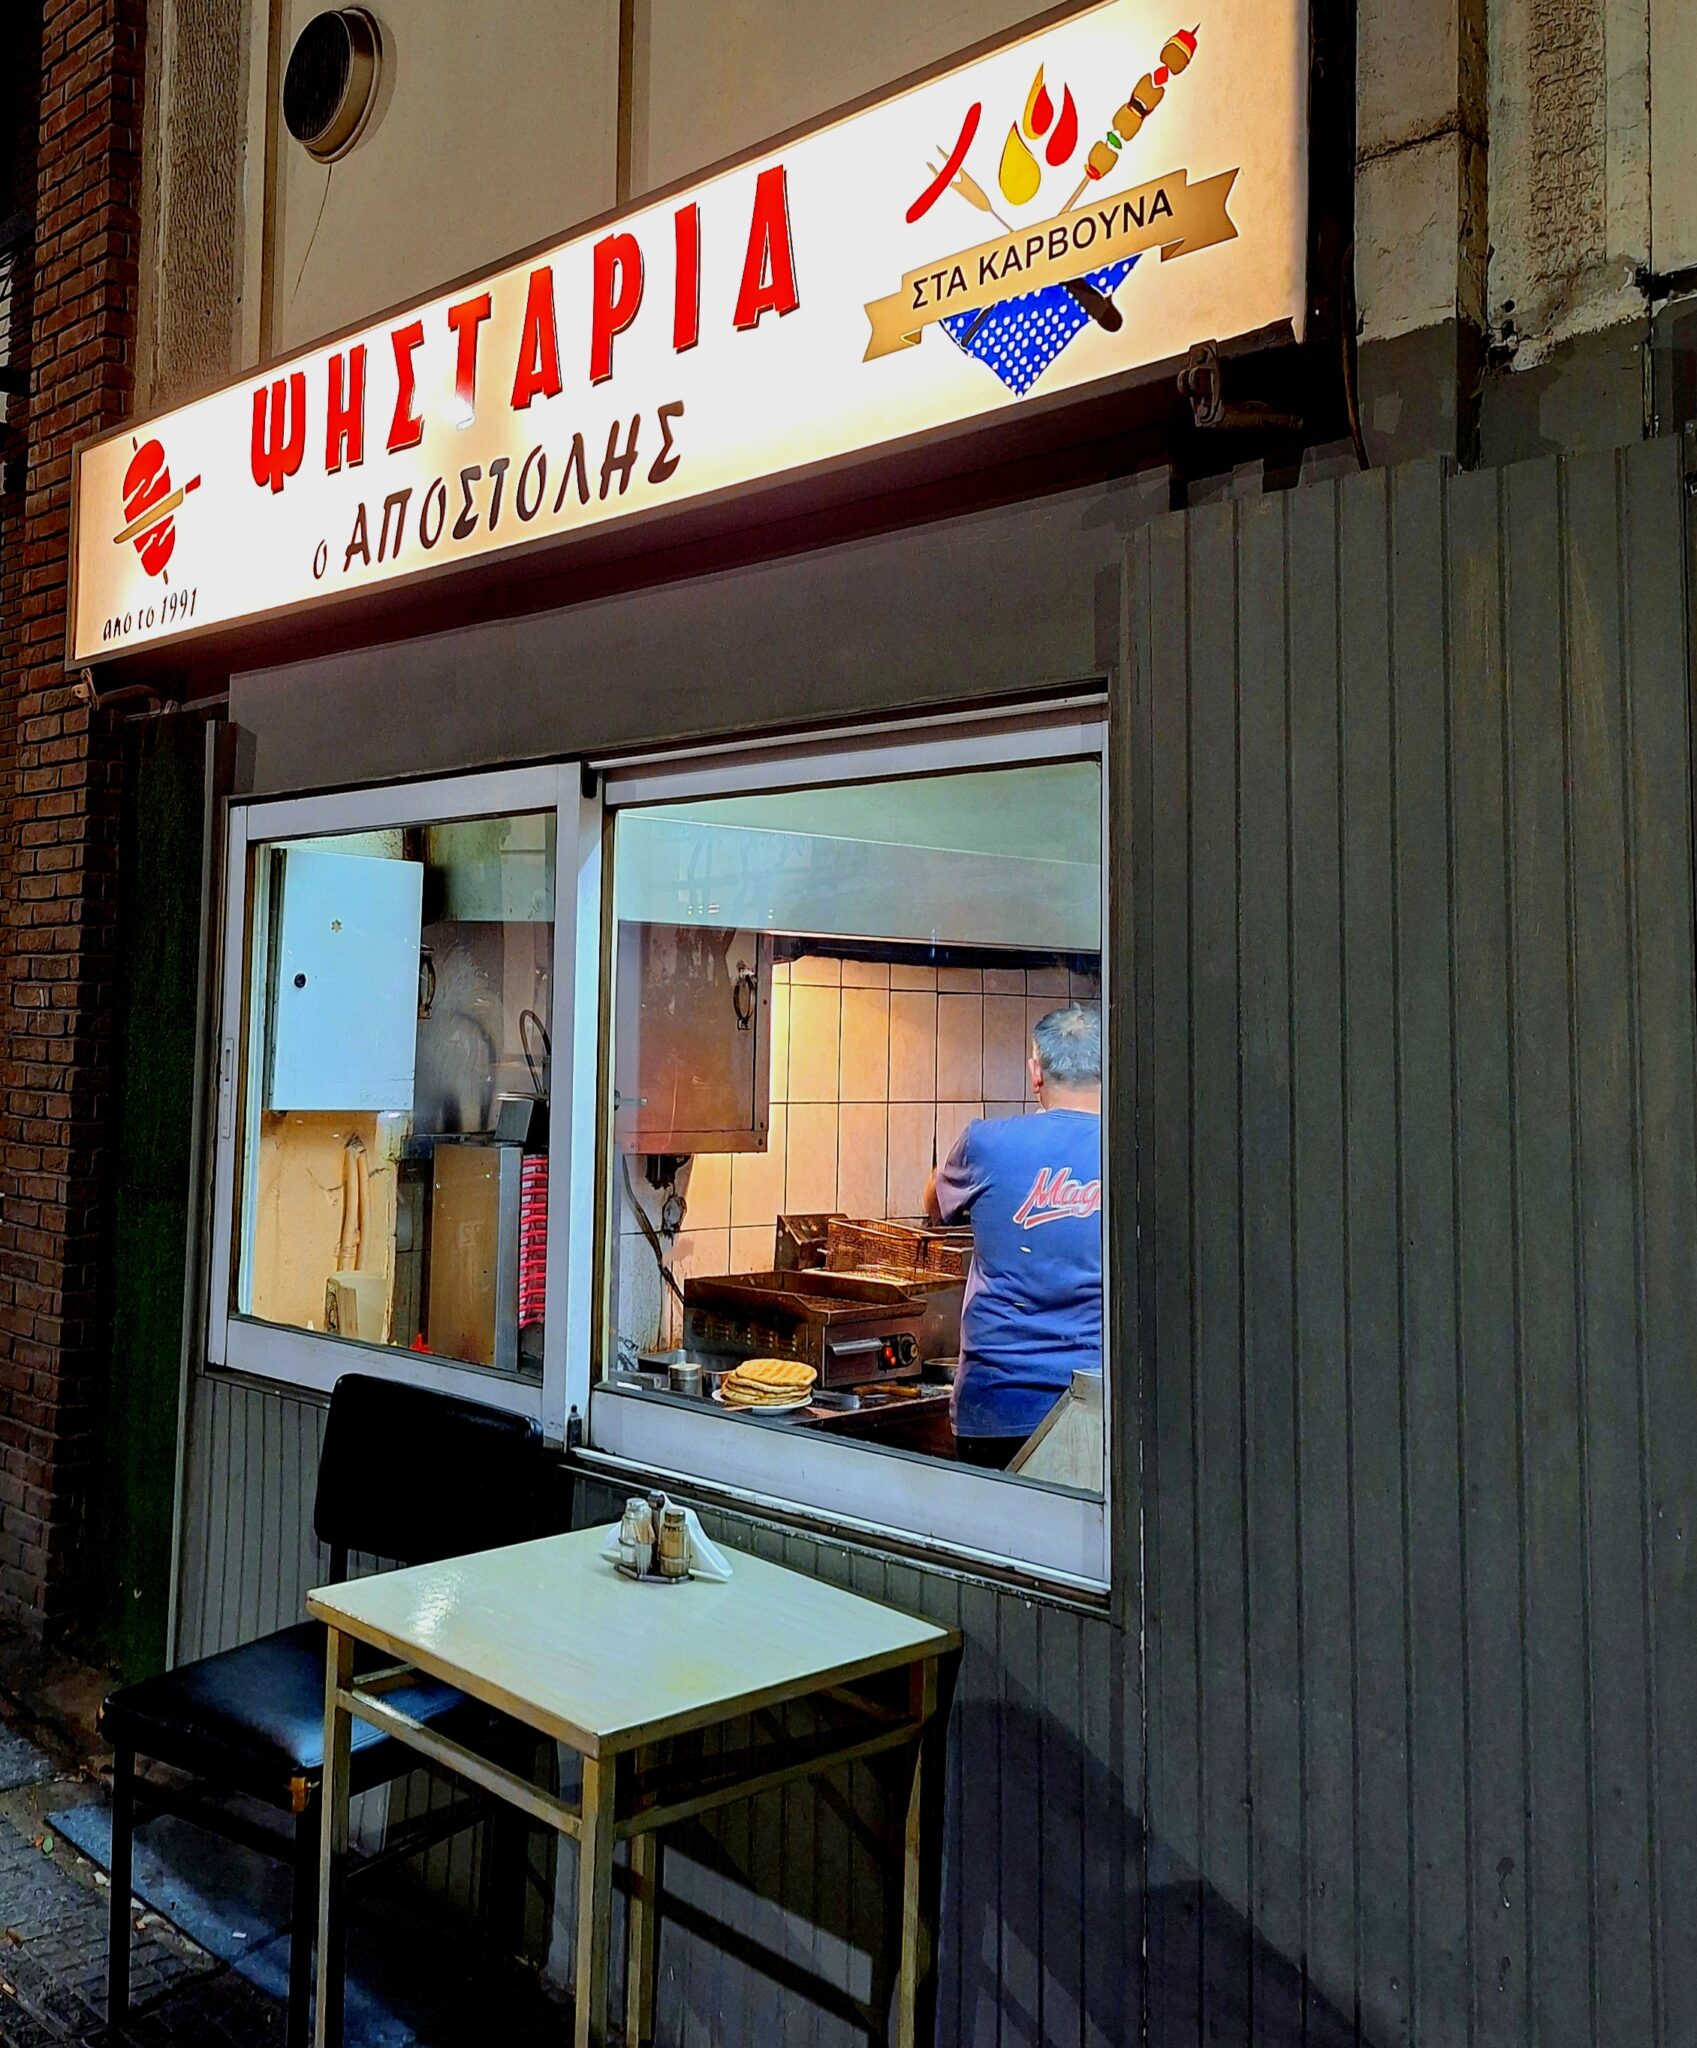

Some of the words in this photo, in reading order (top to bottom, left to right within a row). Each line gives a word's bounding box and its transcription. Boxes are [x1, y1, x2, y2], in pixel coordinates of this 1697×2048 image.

[912, 265, 968, 310] ΣΤΑ
[978, 188, 1174, 286] ΚΑΡΒΟΥΝΑ
[250, 164, 800, 495] ΨΗΣΤΑΡΙΑ
[342, 400, 685, 573] ΑΠΟΣΤΟΛΗΣ
[161, 587, 197, 625] 1991
